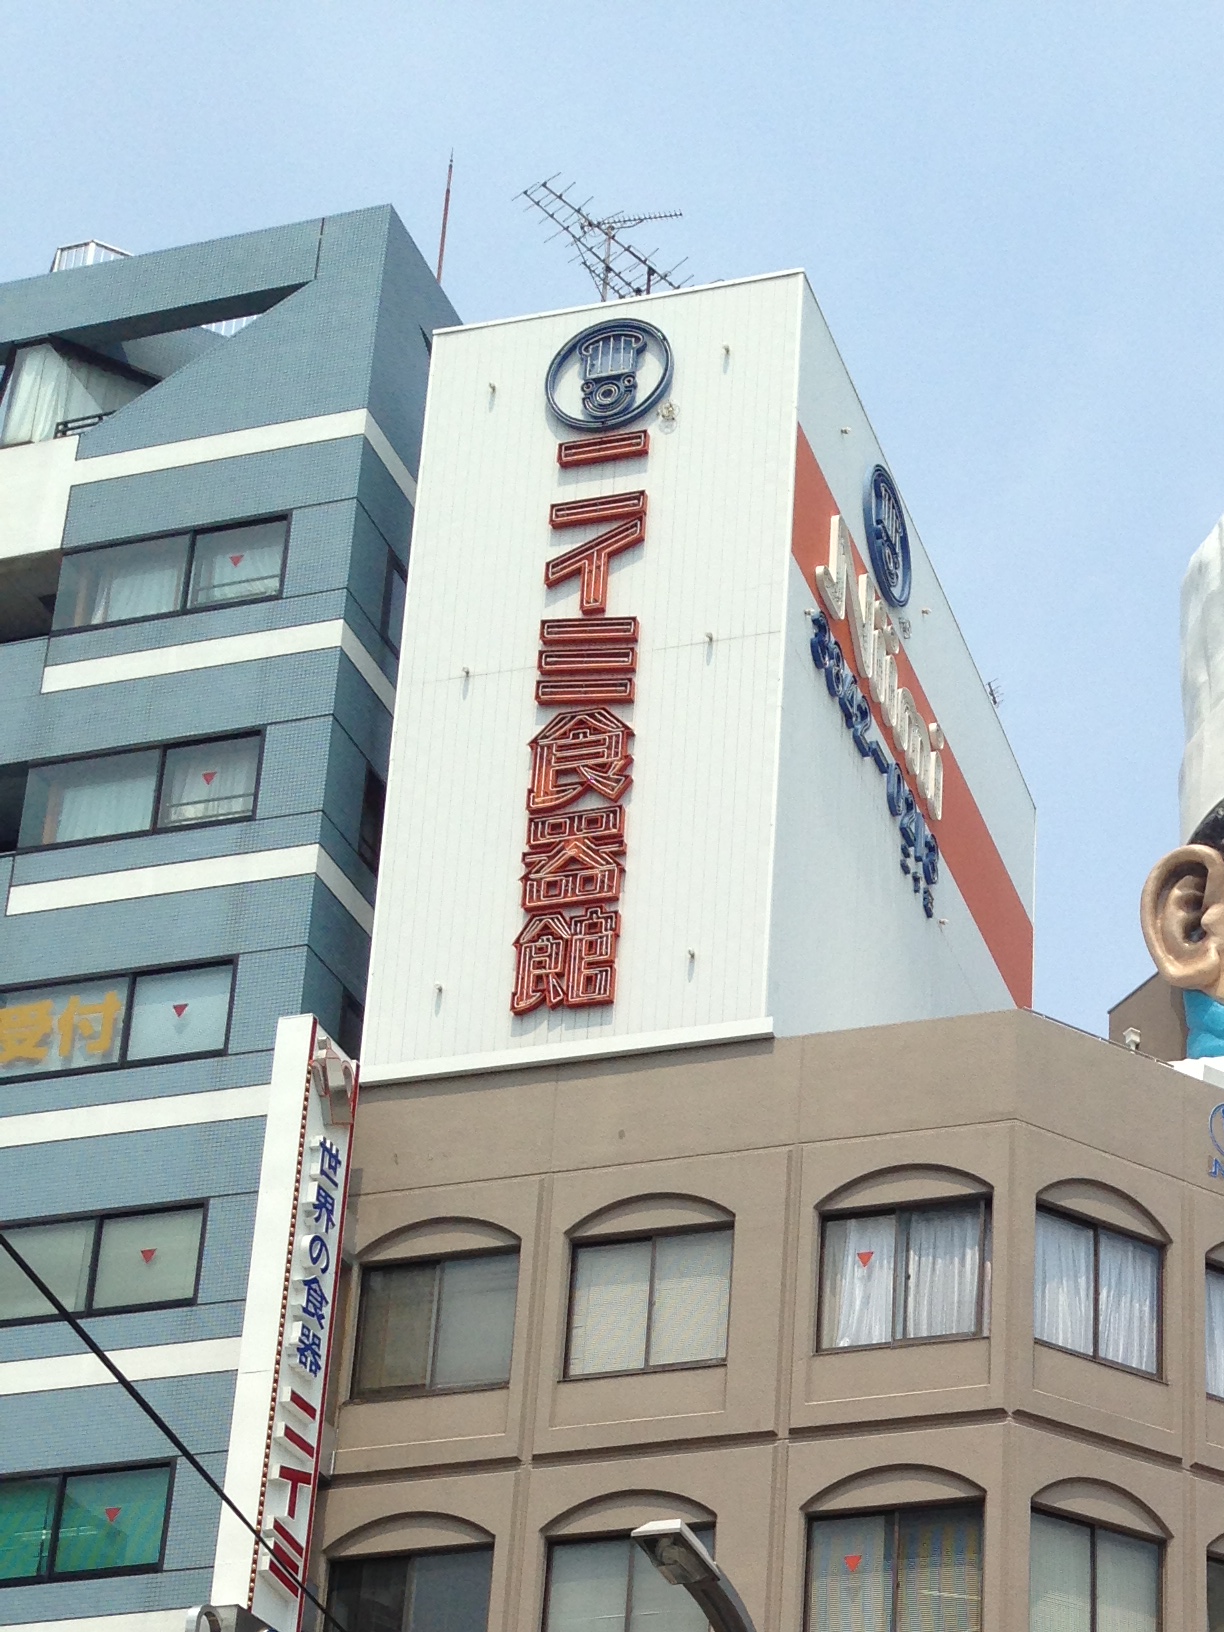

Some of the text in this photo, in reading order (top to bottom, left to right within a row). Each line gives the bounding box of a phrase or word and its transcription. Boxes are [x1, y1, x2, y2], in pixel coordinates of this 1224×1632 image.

[511, 430, 649, 1014] ニイミ食器館
[297, 1136, 342, 1379] 世界の食器
[266, 1392, 317, 1599] ニイミ
